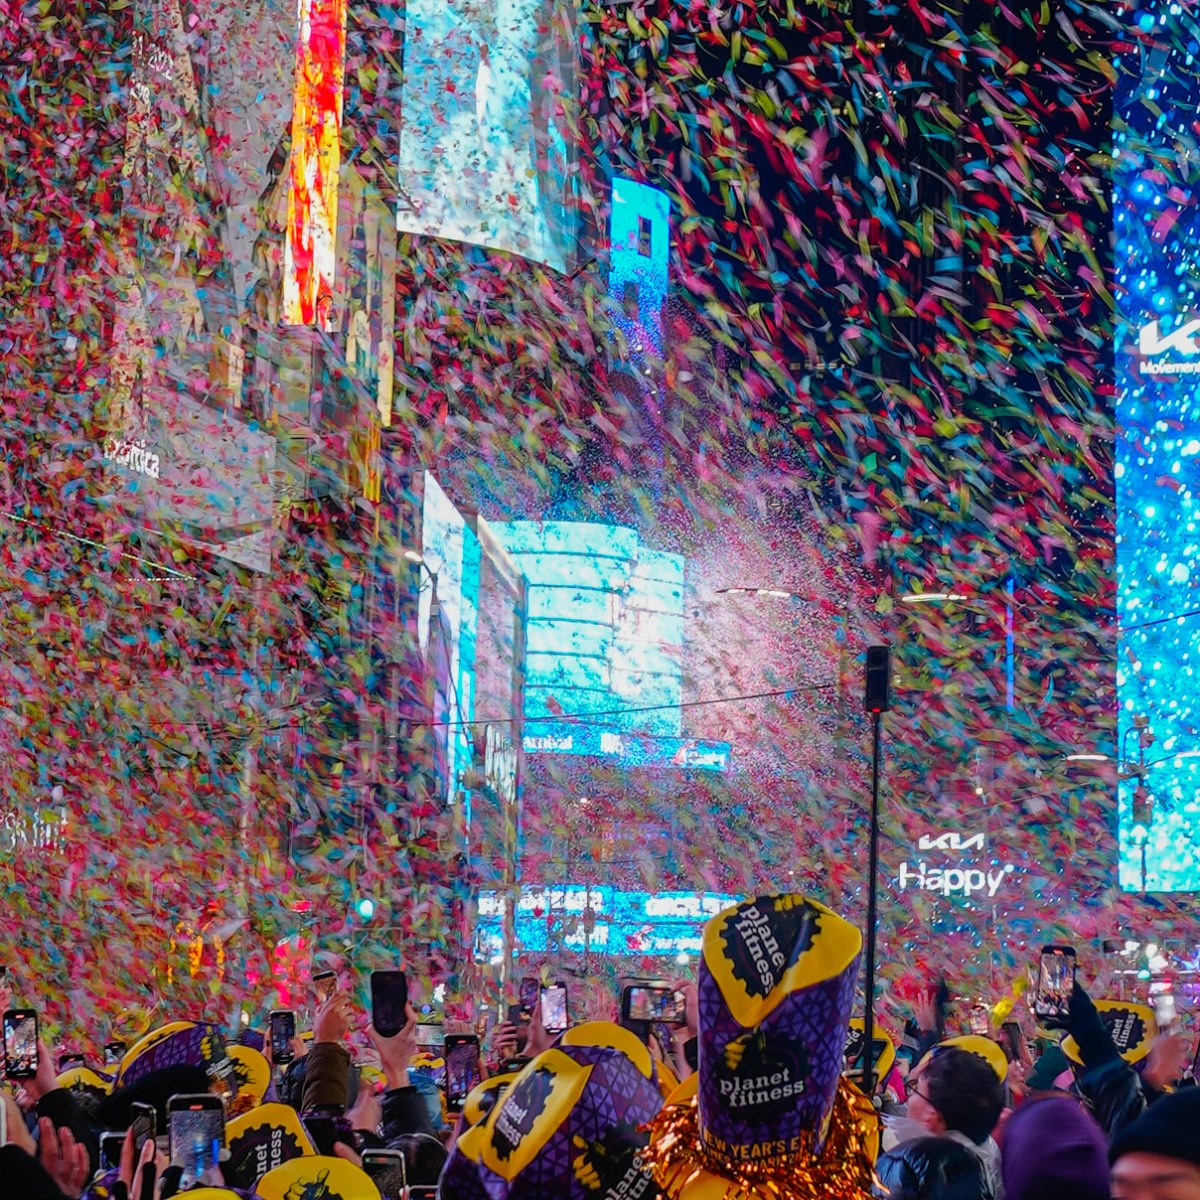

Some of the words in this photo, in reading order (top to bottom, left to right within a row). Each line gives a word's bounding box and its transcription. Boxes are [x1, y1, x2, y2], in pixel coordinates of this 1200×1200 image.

[899, 861, 1005, 897] Happy
[739, 905, 786, 972] plane
[719, 1067, 791, 1096] planet
[729, 1077, 805, 1108] fitness
[731, 1138, 787, 1159] YEAR'S
